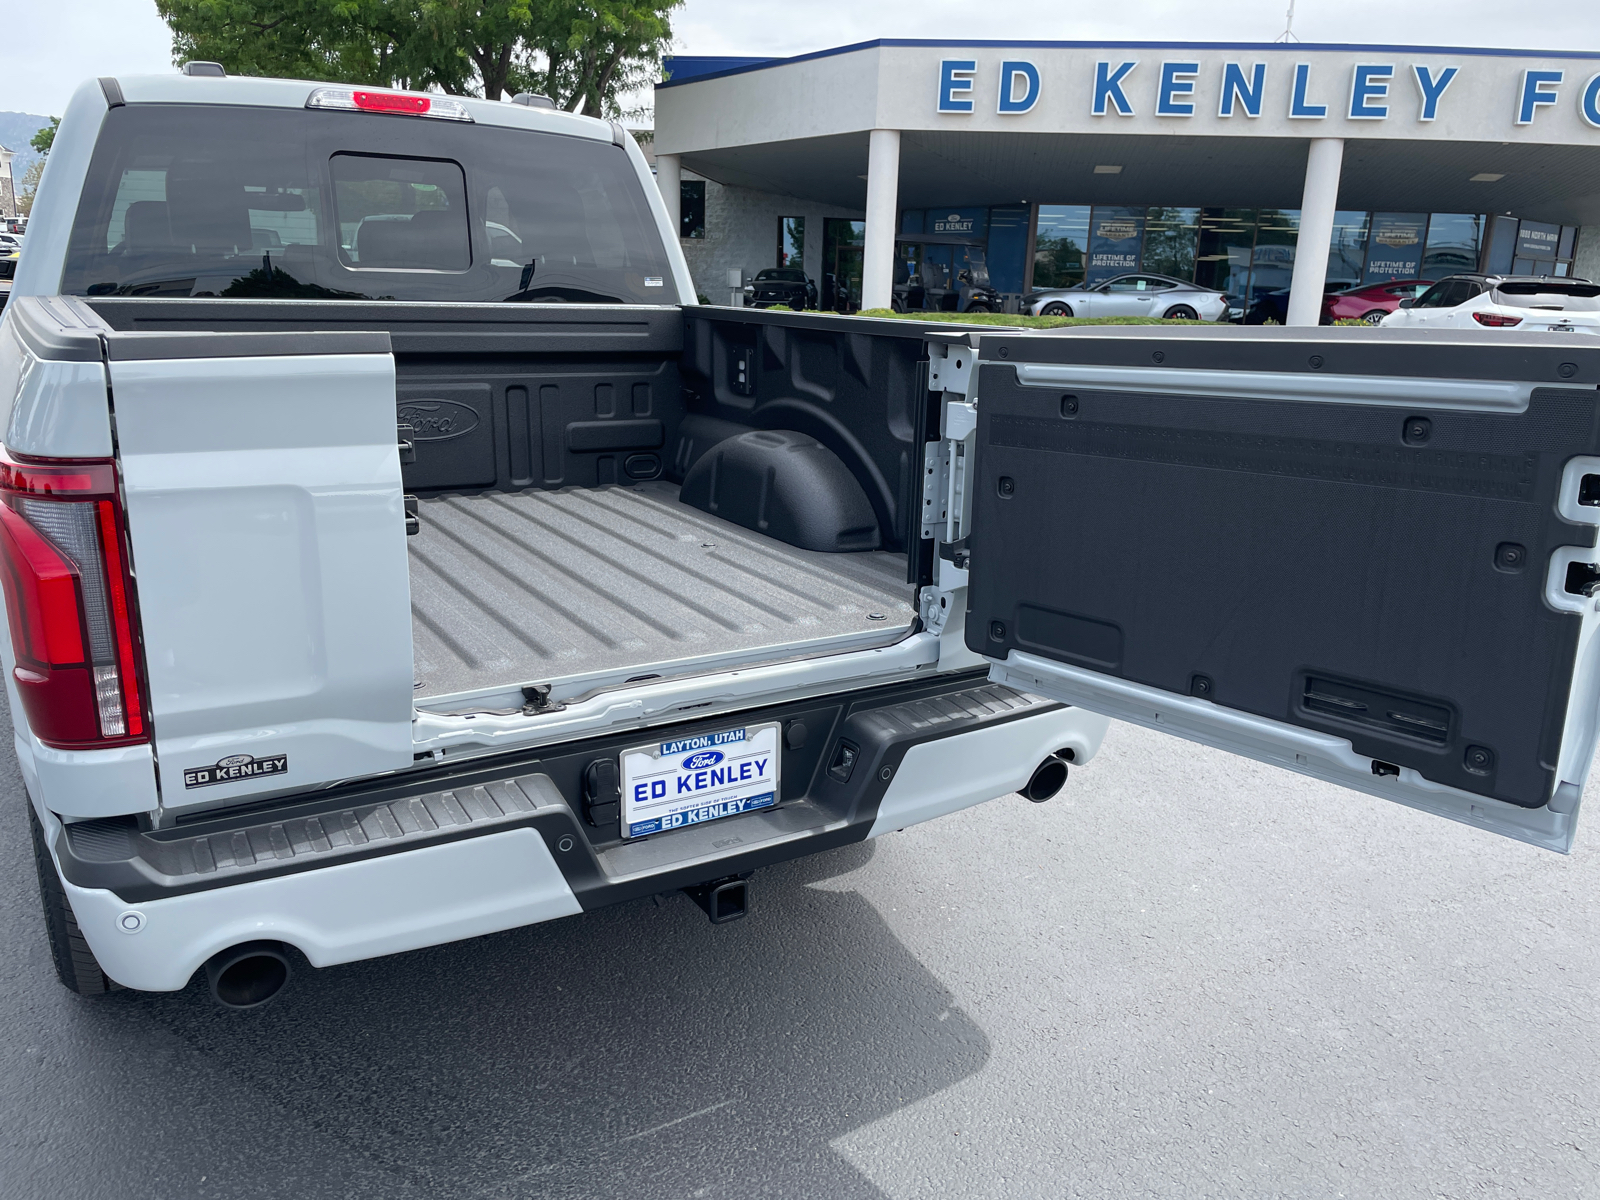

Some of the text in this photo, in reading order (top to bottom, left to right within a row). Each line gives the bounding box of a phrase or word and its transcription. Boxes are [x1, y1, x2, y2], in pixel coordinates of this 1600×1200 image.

[937, 59, 1042, 115] ED
[1091, 60, 1462, 122] KENLEY
[946, 222, 973, 230] KENLEY
[397, 405, 458, 433] Ford
[662, 729, 744, 755] LAYTON, UTAH
[185, 759, 285, 785] ED KENLEY
[225, 757, 245, 766] Ford
[690, 753, 716, 769] Ford
[634, 758, 768, 802] ED KENLEY
[661, 798, 747, 829] ED KENLEY
